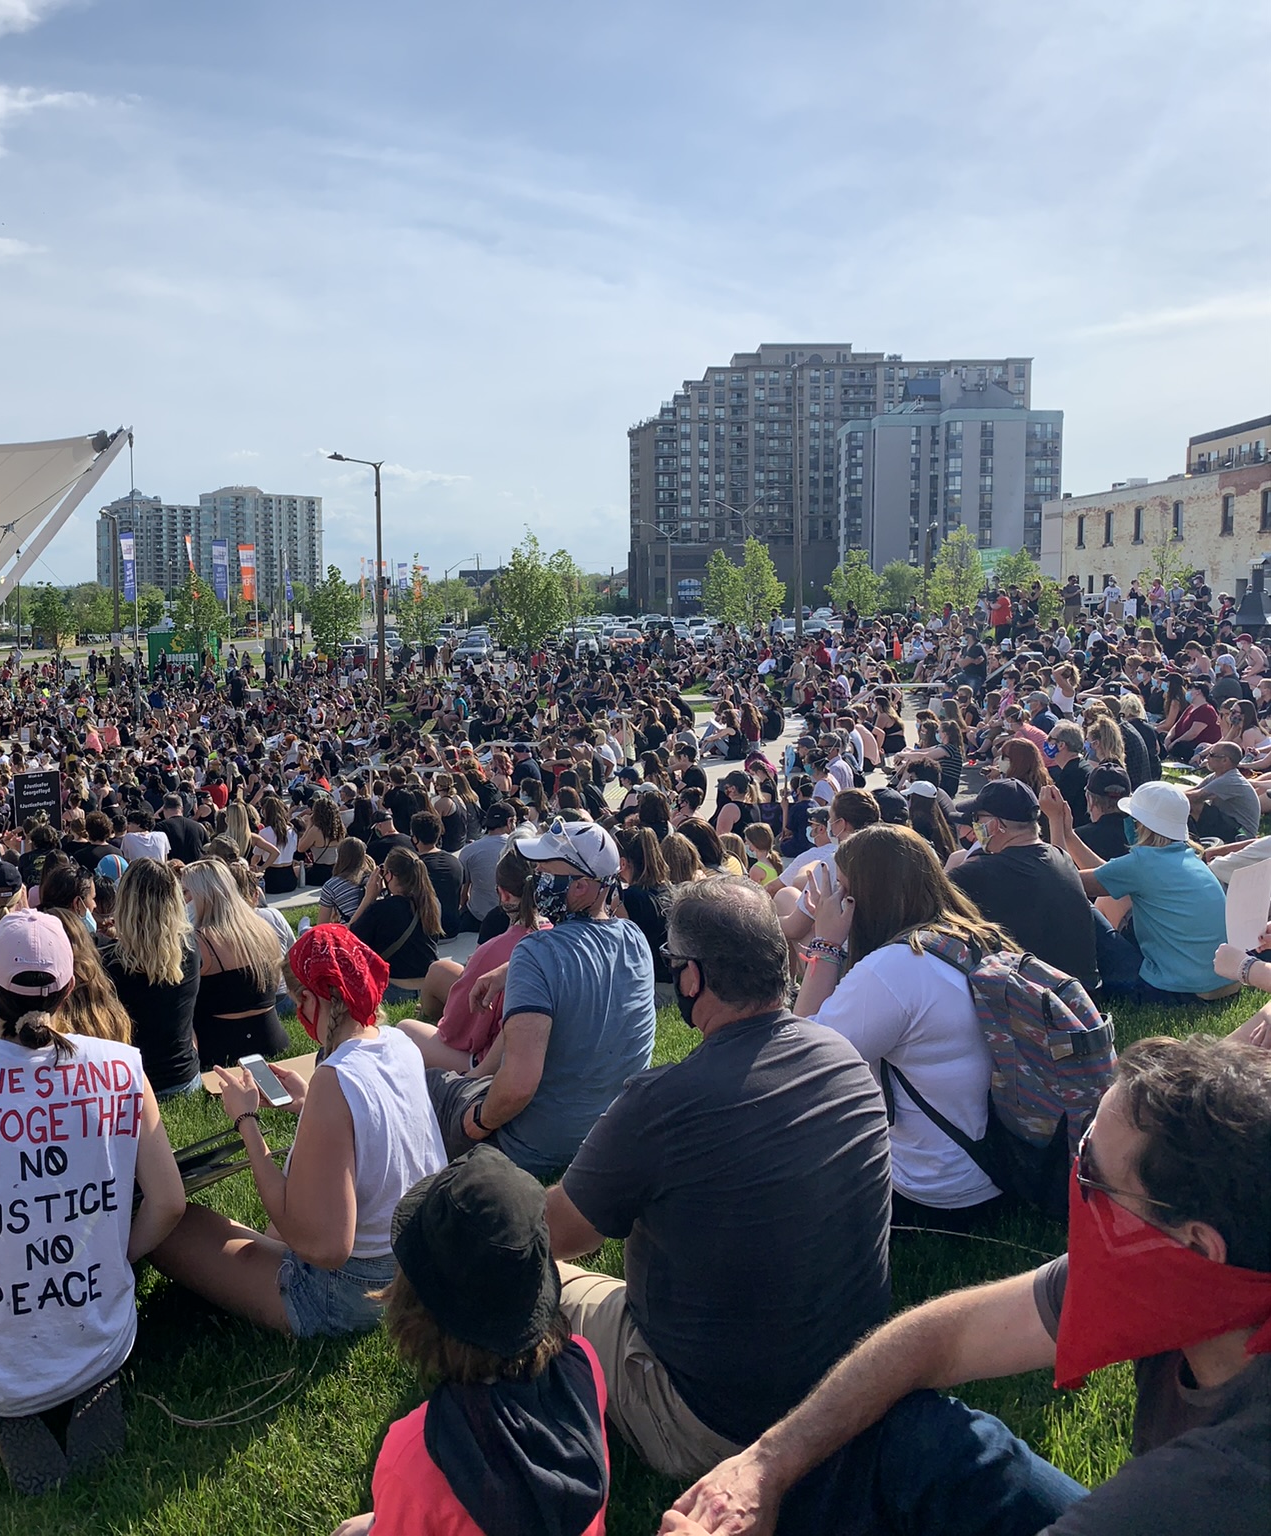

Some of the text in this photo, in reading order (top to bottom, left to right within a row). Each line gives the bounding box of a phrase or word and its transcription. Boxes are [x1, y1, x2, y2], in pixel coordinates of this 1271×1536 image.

[34, 1059, 132, 1098] STAND
[20, 1145, 68, 1181] NO
[26, 1234, 74, 1270] NO
